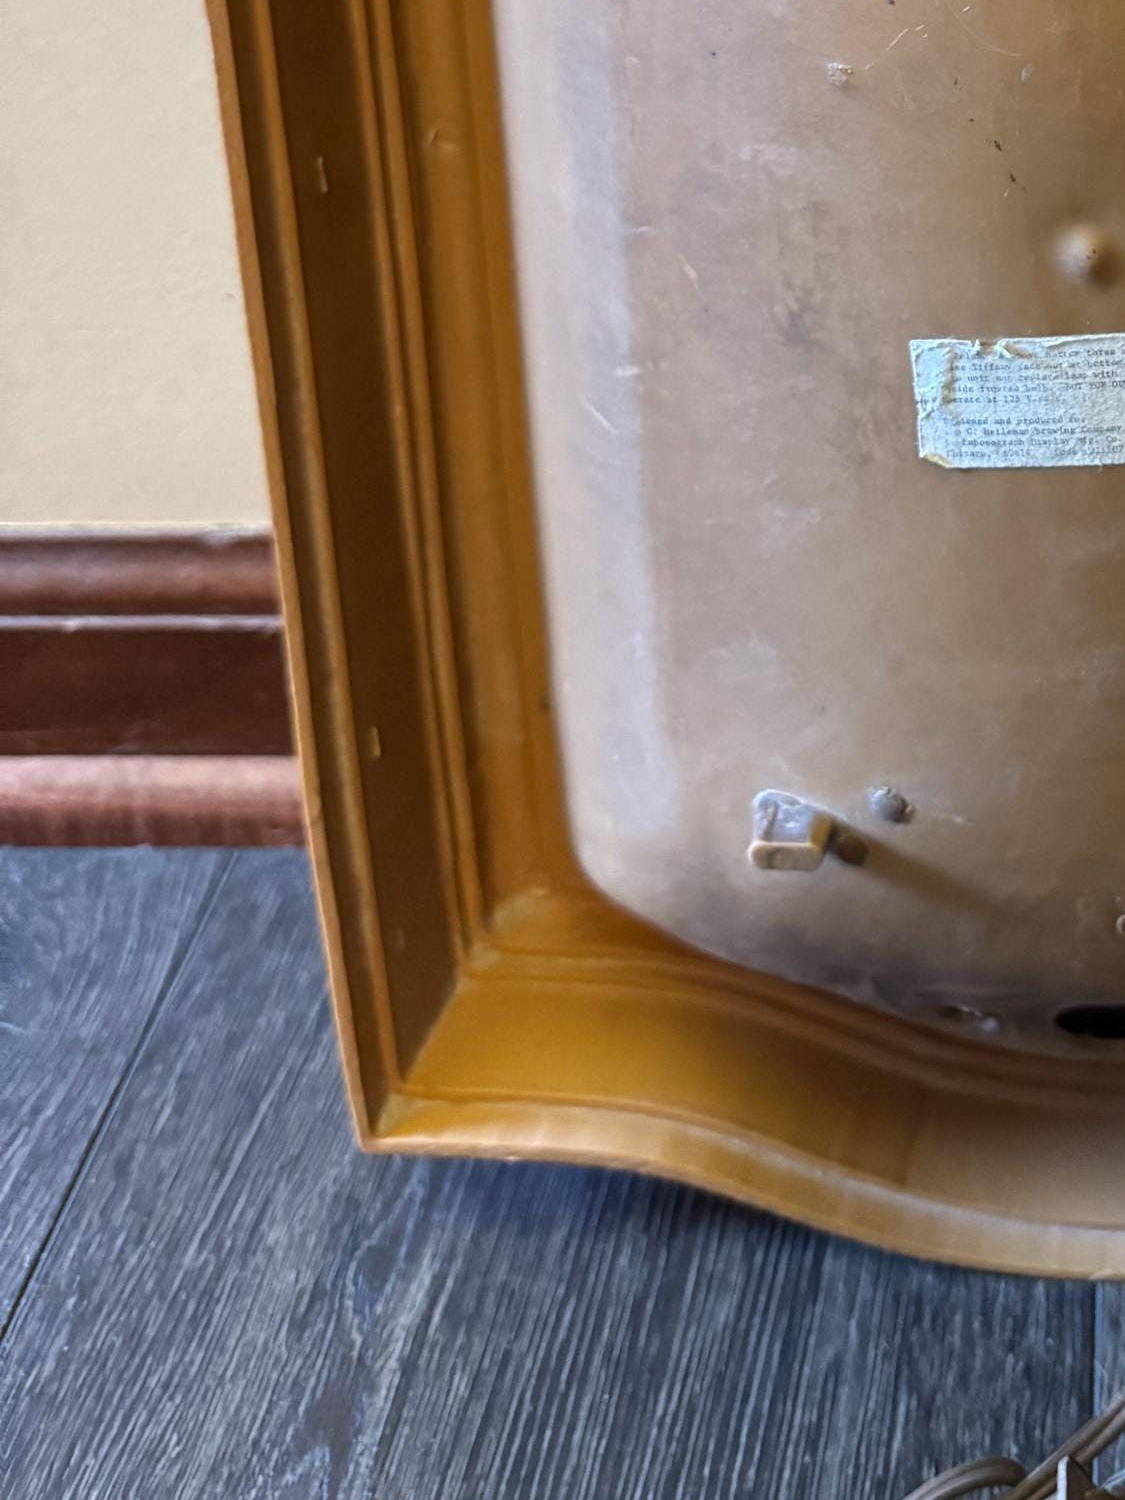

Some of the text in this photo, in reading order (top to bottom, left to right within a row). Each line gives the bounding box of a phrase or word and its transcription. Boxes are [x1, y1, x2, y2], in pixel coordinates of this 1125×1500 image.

[1086, 347, 1116, 358] three
[971, 362, 1010, 374] Tiffany
[994, 415, 1012, 426] and
[982, 426, 1029, 437] Heileman
[1105, 433, 1123, 444] Co.
